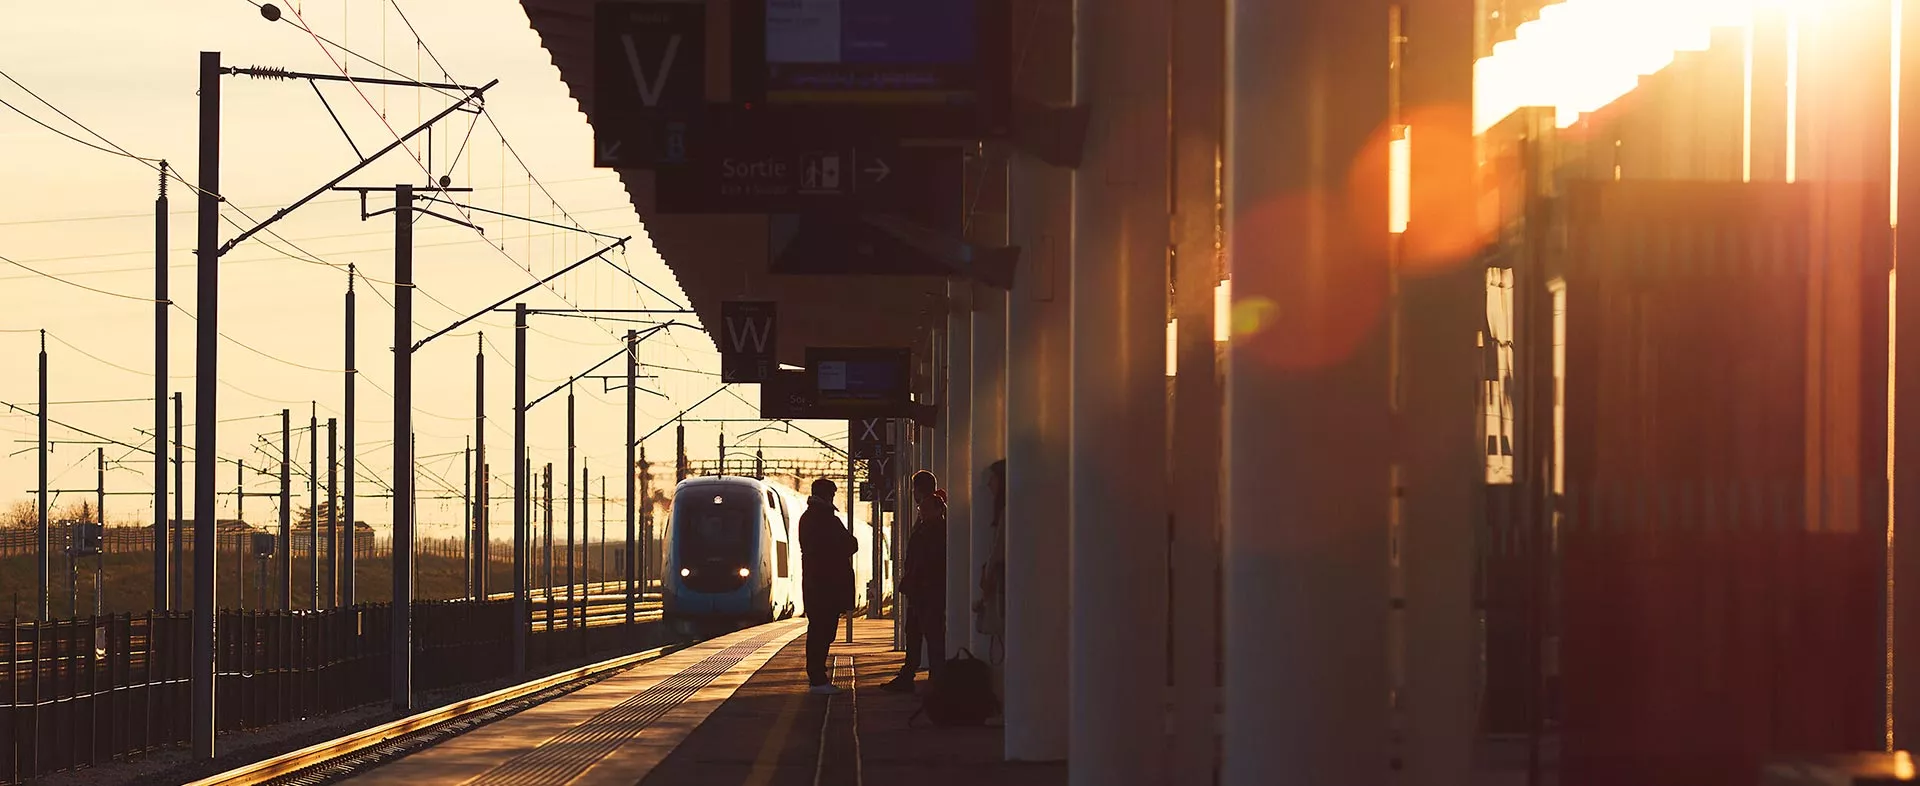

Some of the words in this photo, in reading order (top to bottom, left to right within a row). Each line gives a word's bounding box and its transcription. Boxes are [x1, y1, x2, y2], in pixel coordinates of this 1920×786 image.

[620, 33, 682, 107] V
[721, 155, 787, 178] Sortie
[725, 316, 772, 353] W
[860, 418, 880, 441] X
[876, 457, 890, 476] Y
